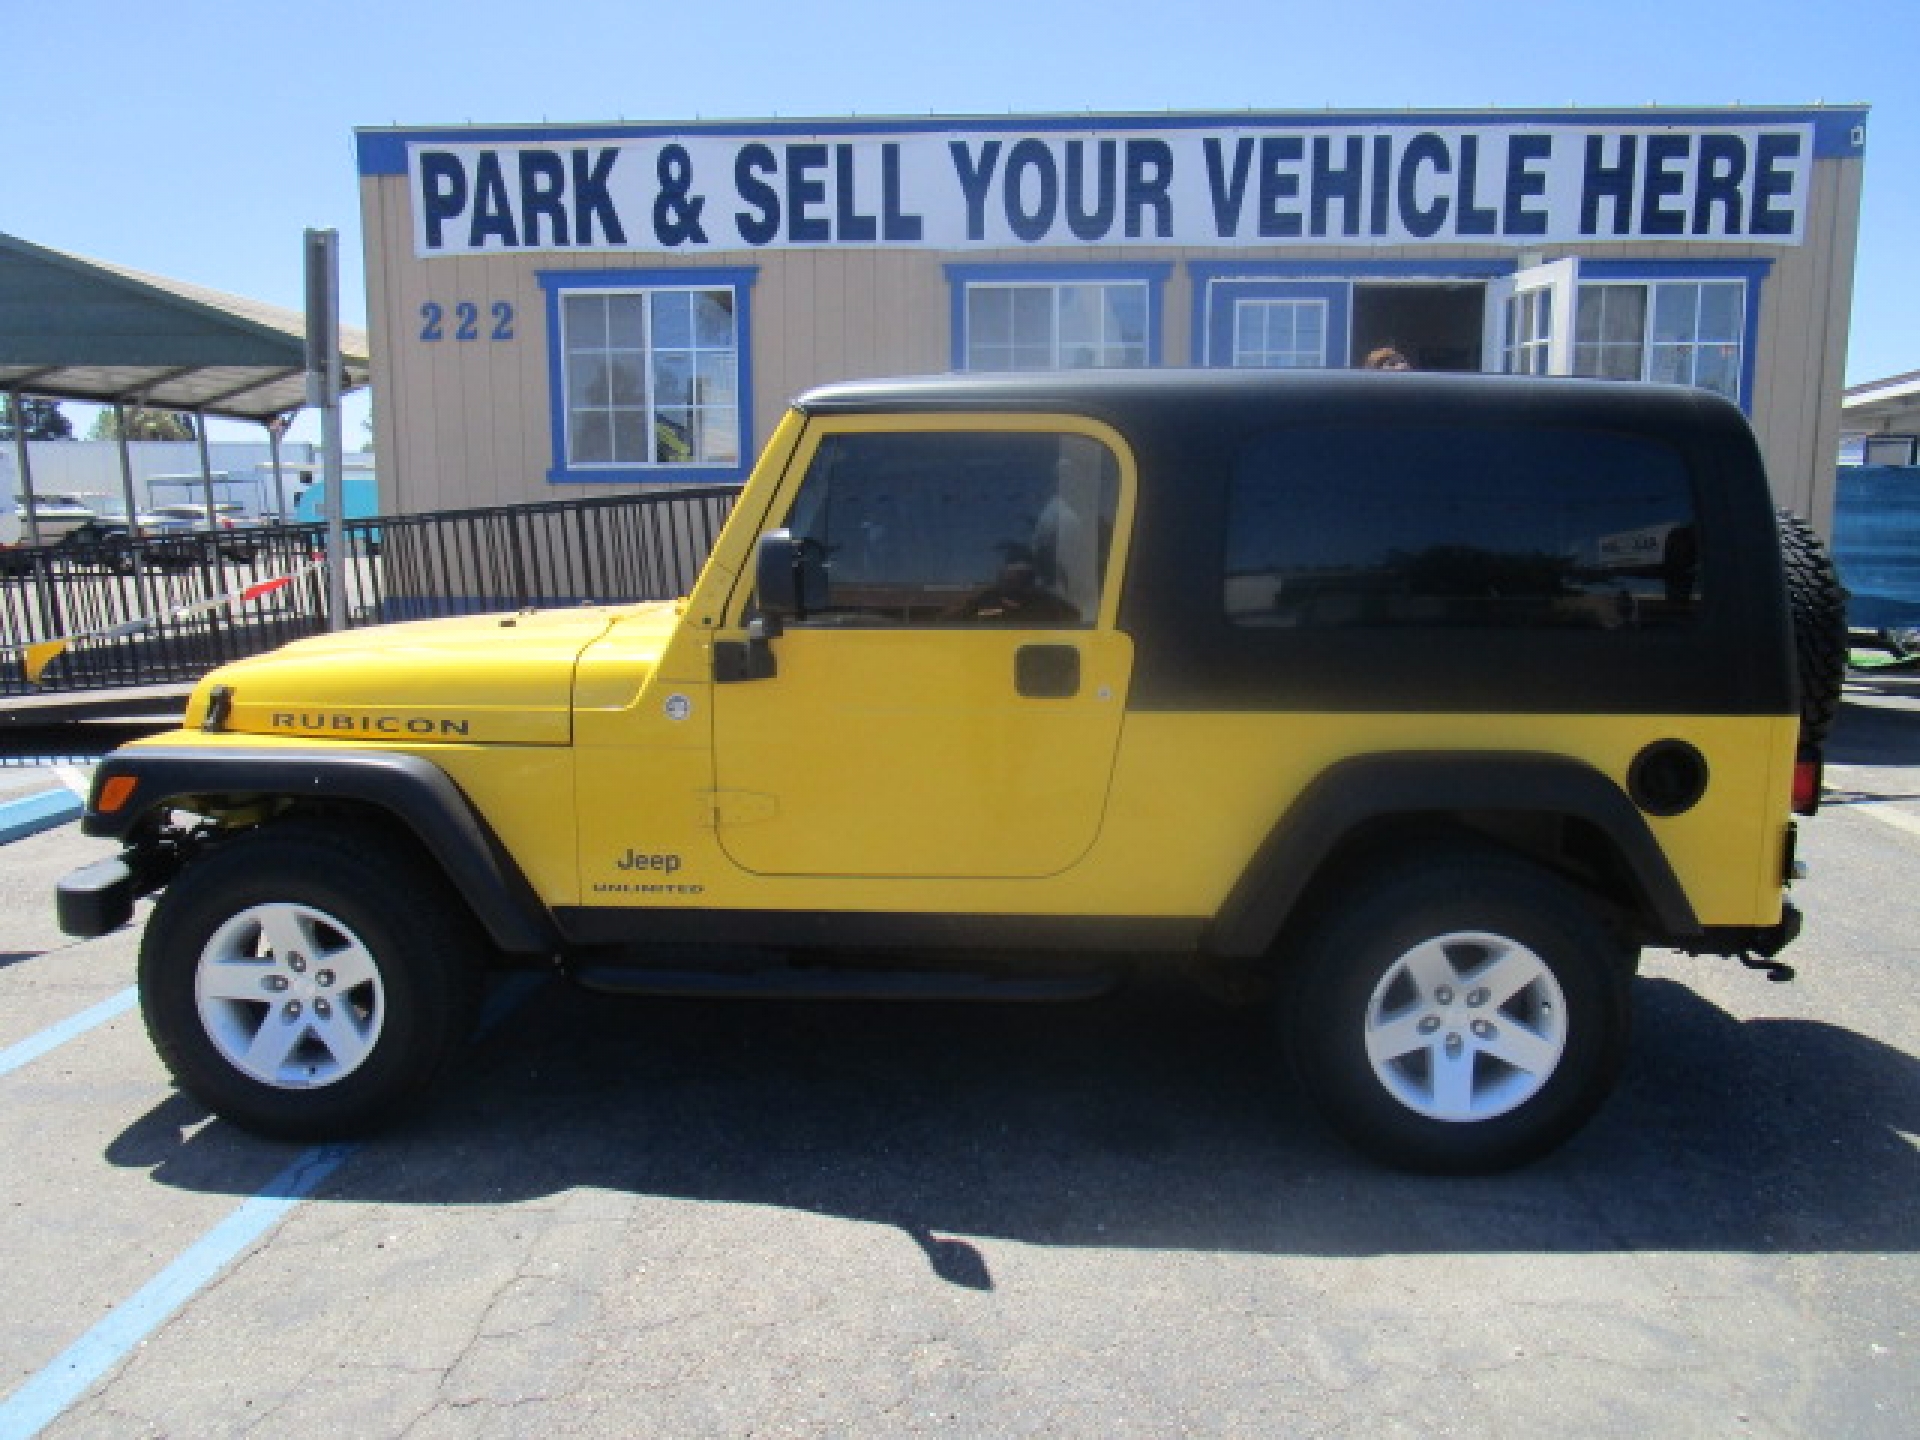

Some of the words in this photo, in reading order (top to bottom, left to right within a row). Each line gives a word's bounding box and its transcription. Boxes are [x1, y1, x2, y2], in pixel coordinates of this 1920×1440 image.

[420, 149, 627, 249] PARK
[653, 142, 706, 246] &
[734, 142, 922, 246] SELL
[949, 137, 1174, 242] YOUR
[1203, 132, 1551, 238] VEHICLE
[1580, 133, 1801, 237] HERE
[419, 302, 514, 340] 222
[272, 713, 470, 736] RUBICON
[617, 849, 682, 875] Jeep
[593, 884, 705, 894] UNLIMITED
